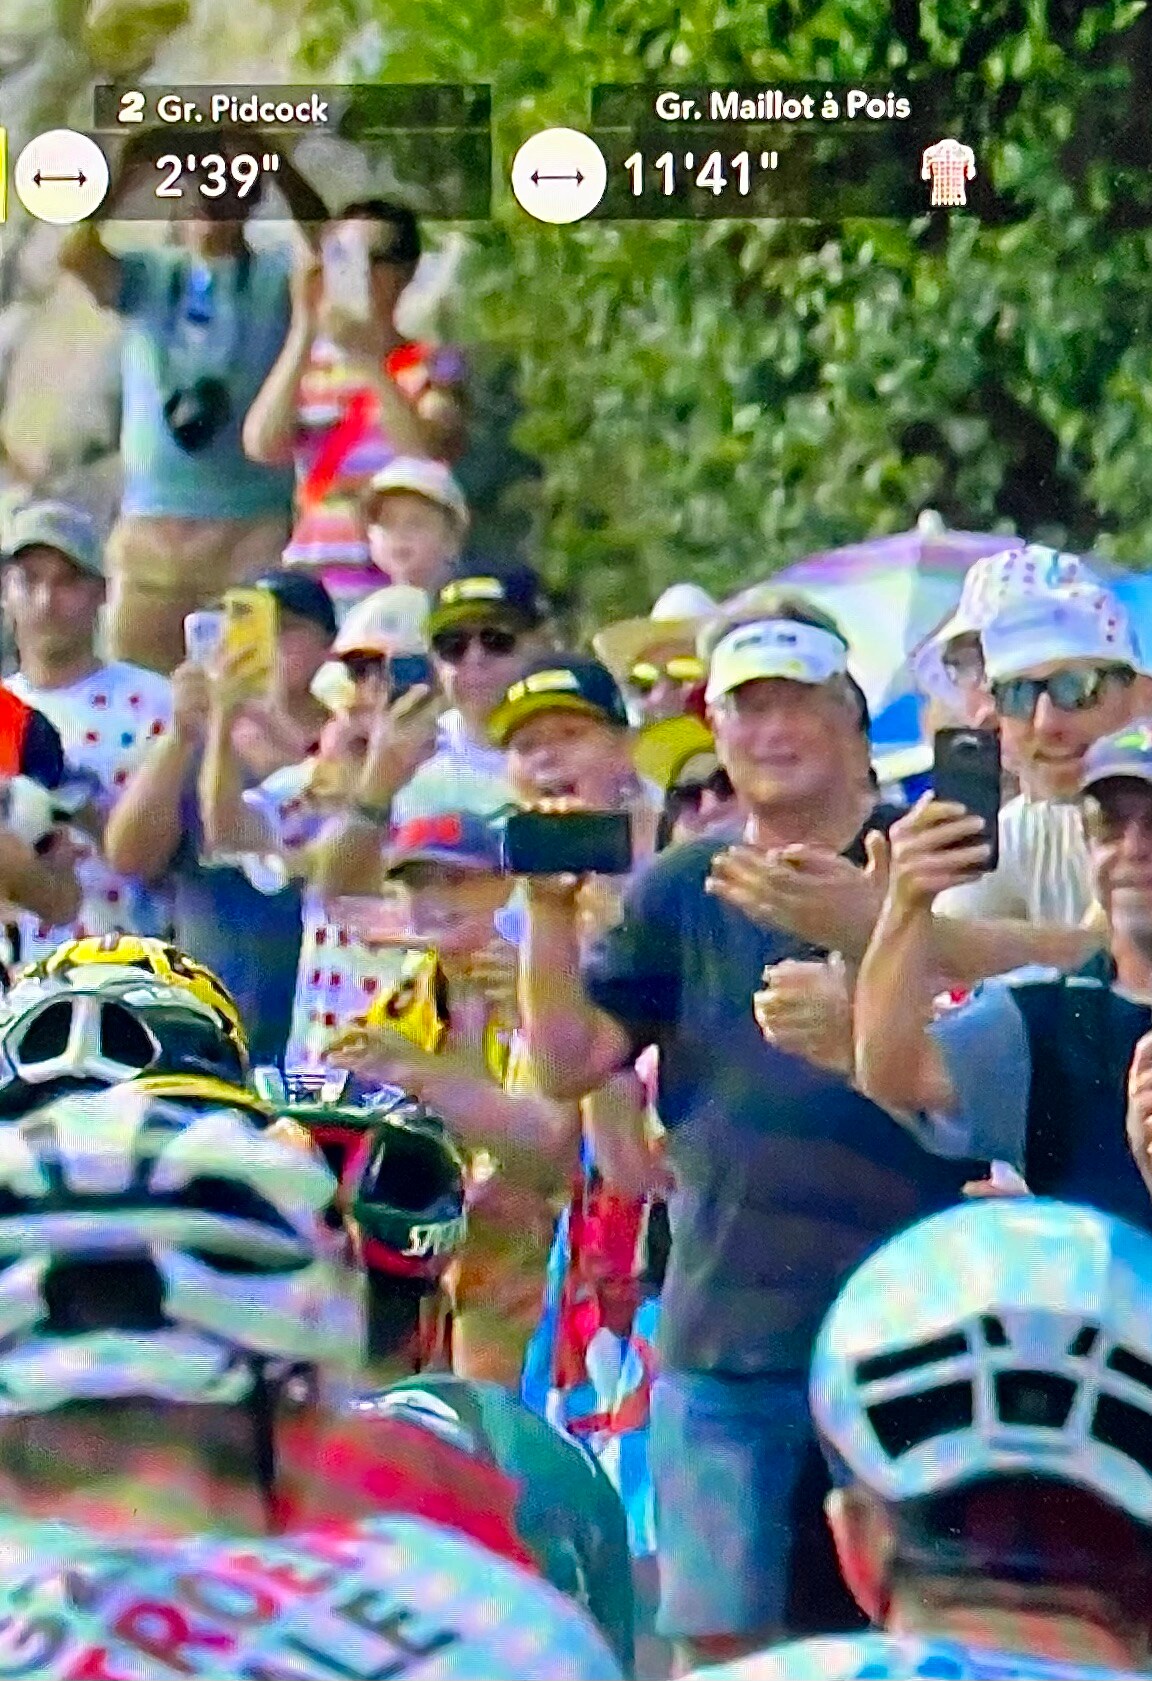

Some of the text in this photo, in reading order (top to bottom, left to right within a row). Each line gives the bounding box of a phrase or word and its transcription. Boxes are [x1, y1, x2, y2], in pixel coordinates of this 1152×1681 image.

[118, 91, 328, 123] 2 Gr. Pidcock
[655, 90, 911, 121] Gr. Maillot à Pois
[154, 153, 280, 199] 2'39"
[624, 151, 779, 197] 11'41"
